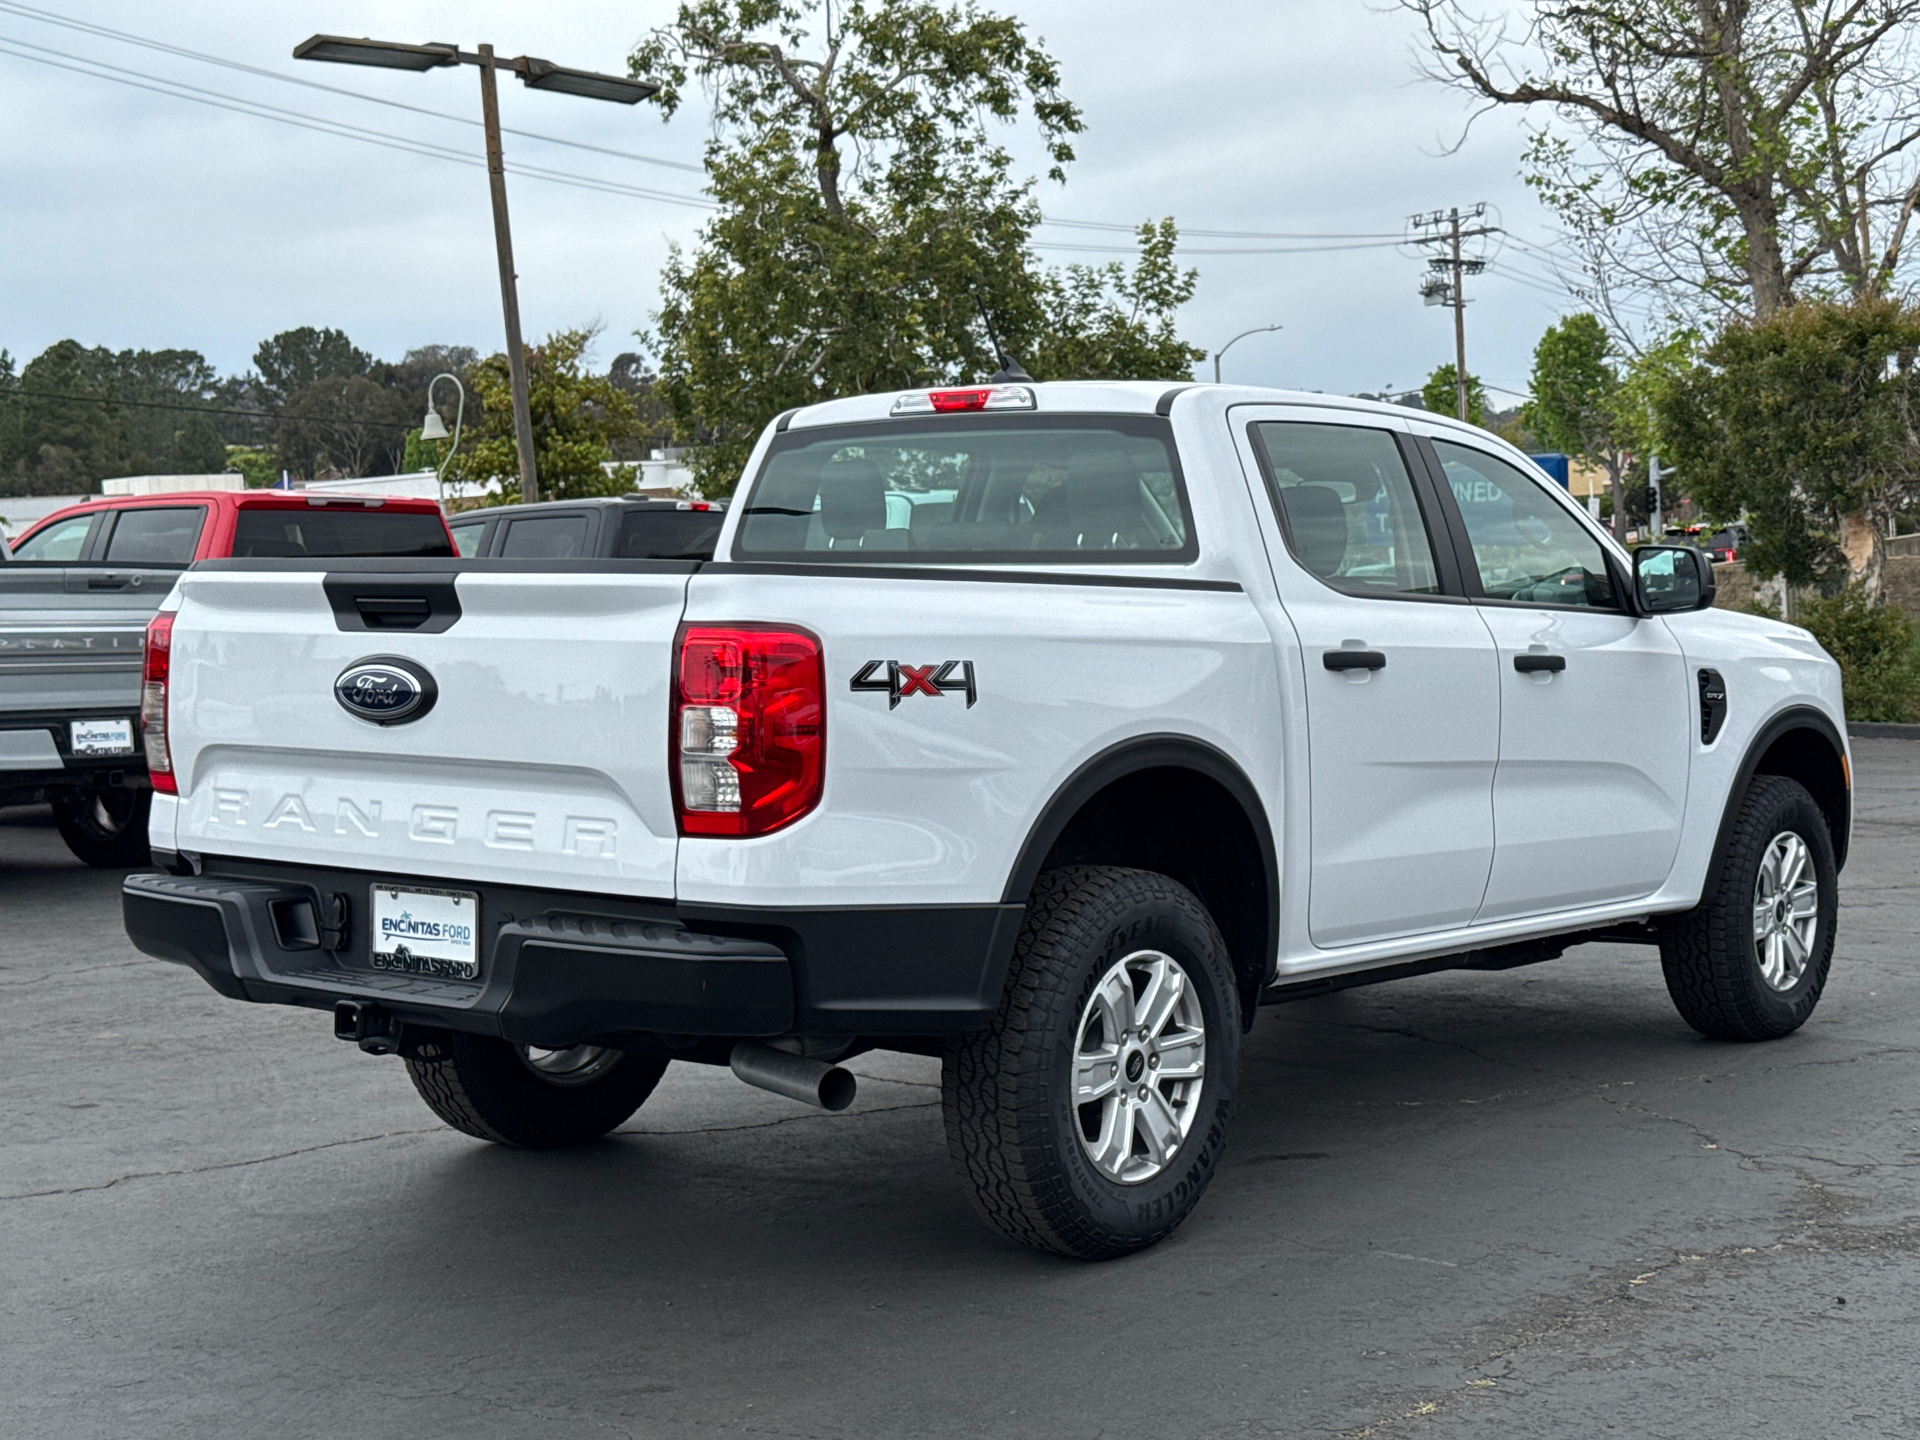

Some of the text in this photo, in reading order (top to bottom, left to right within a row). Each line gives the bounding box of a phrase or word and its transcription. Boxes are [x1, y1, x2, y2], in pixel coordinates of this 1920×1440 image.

[352, 674, 399, 706] Ford
[110, 731, 127, 740] FORD
[209, 786, 619, 859] RANGER
[381, 917, 471, 941] ENCINITAS FORD
[1136, 1098, 1231, 1226] WRANGLER
